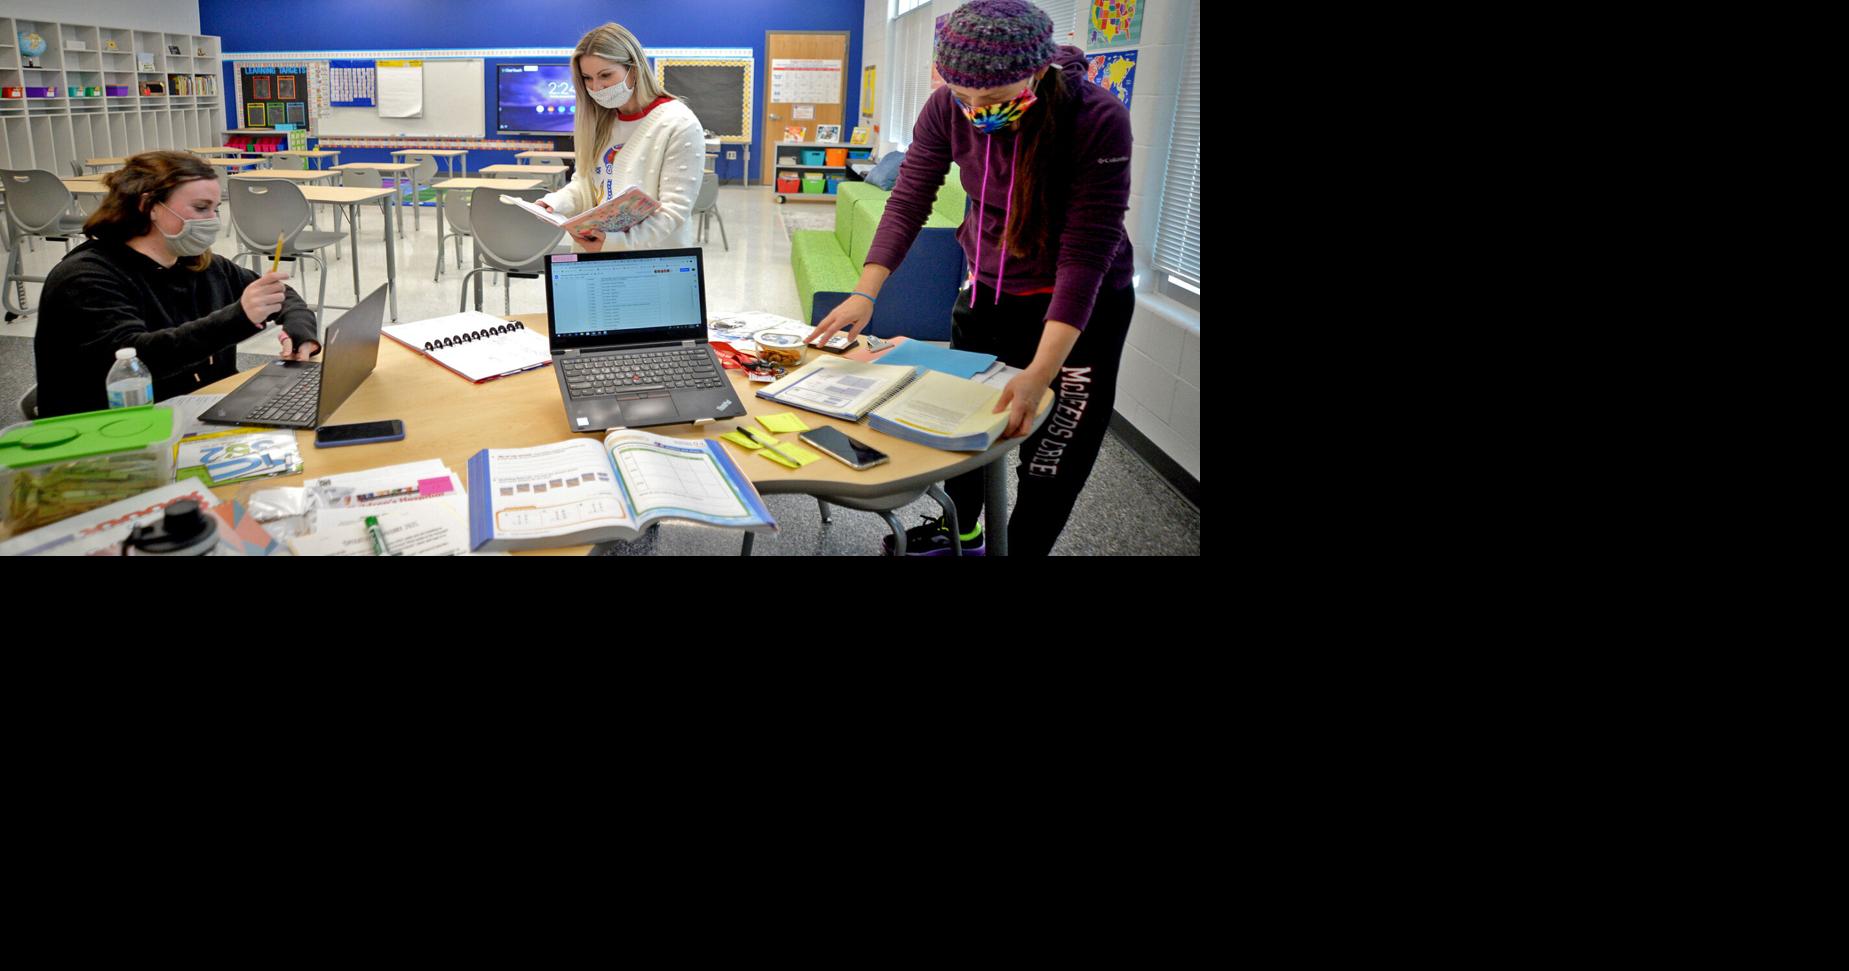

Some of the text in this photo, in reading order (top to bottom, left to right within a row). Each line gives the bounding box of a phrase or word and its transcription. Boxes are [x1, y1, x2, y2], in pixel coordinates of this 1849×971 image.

[245, 66, 306, 75] LEARNING TARGETS
[1028, 438, 1067, 478] CREE
